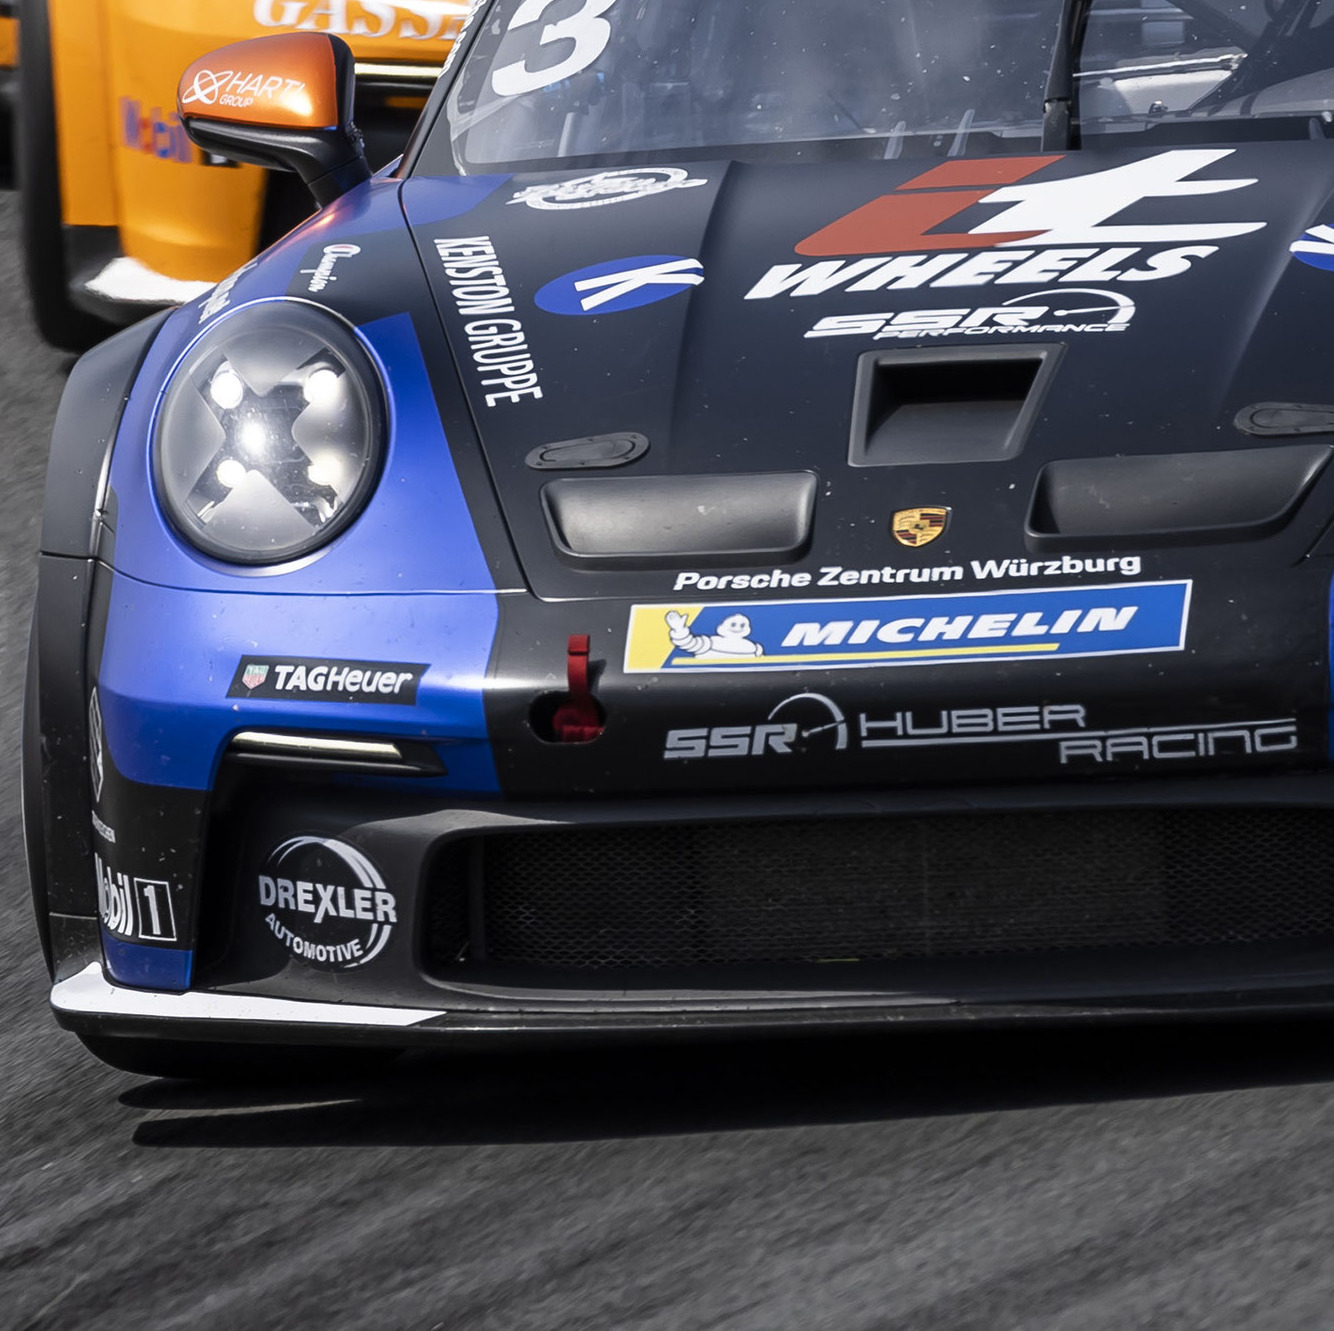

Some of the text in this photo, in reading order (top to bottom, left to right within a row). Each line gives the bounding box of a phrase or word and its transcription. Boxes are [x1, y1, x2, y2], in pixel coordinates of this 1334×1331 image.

[219, 93, 254, 108] GROUP
[744, 246, 1219, 300] WHEELS
[433, 235, 543, 407] KENSTON GRUPPE
[804, 306, 1049, 338] SSR
[873, 323, 1130, 341] PERFORMANCE
[673, 556, 1142, 591] Porsche Zentrum Würzburg
[781, 606, 1140, 647] MICHELIN
[274, 664, 413, 694] TAGHeuer
[859, 704, 1087, 736] HUBER
[664, 723, 798, 759] SSR
[1060, 726, 1298, 765] RACING
[259, 875, 397, 923] DREXLER
[265, 914, 363, 962] AUTOMOTIVE
